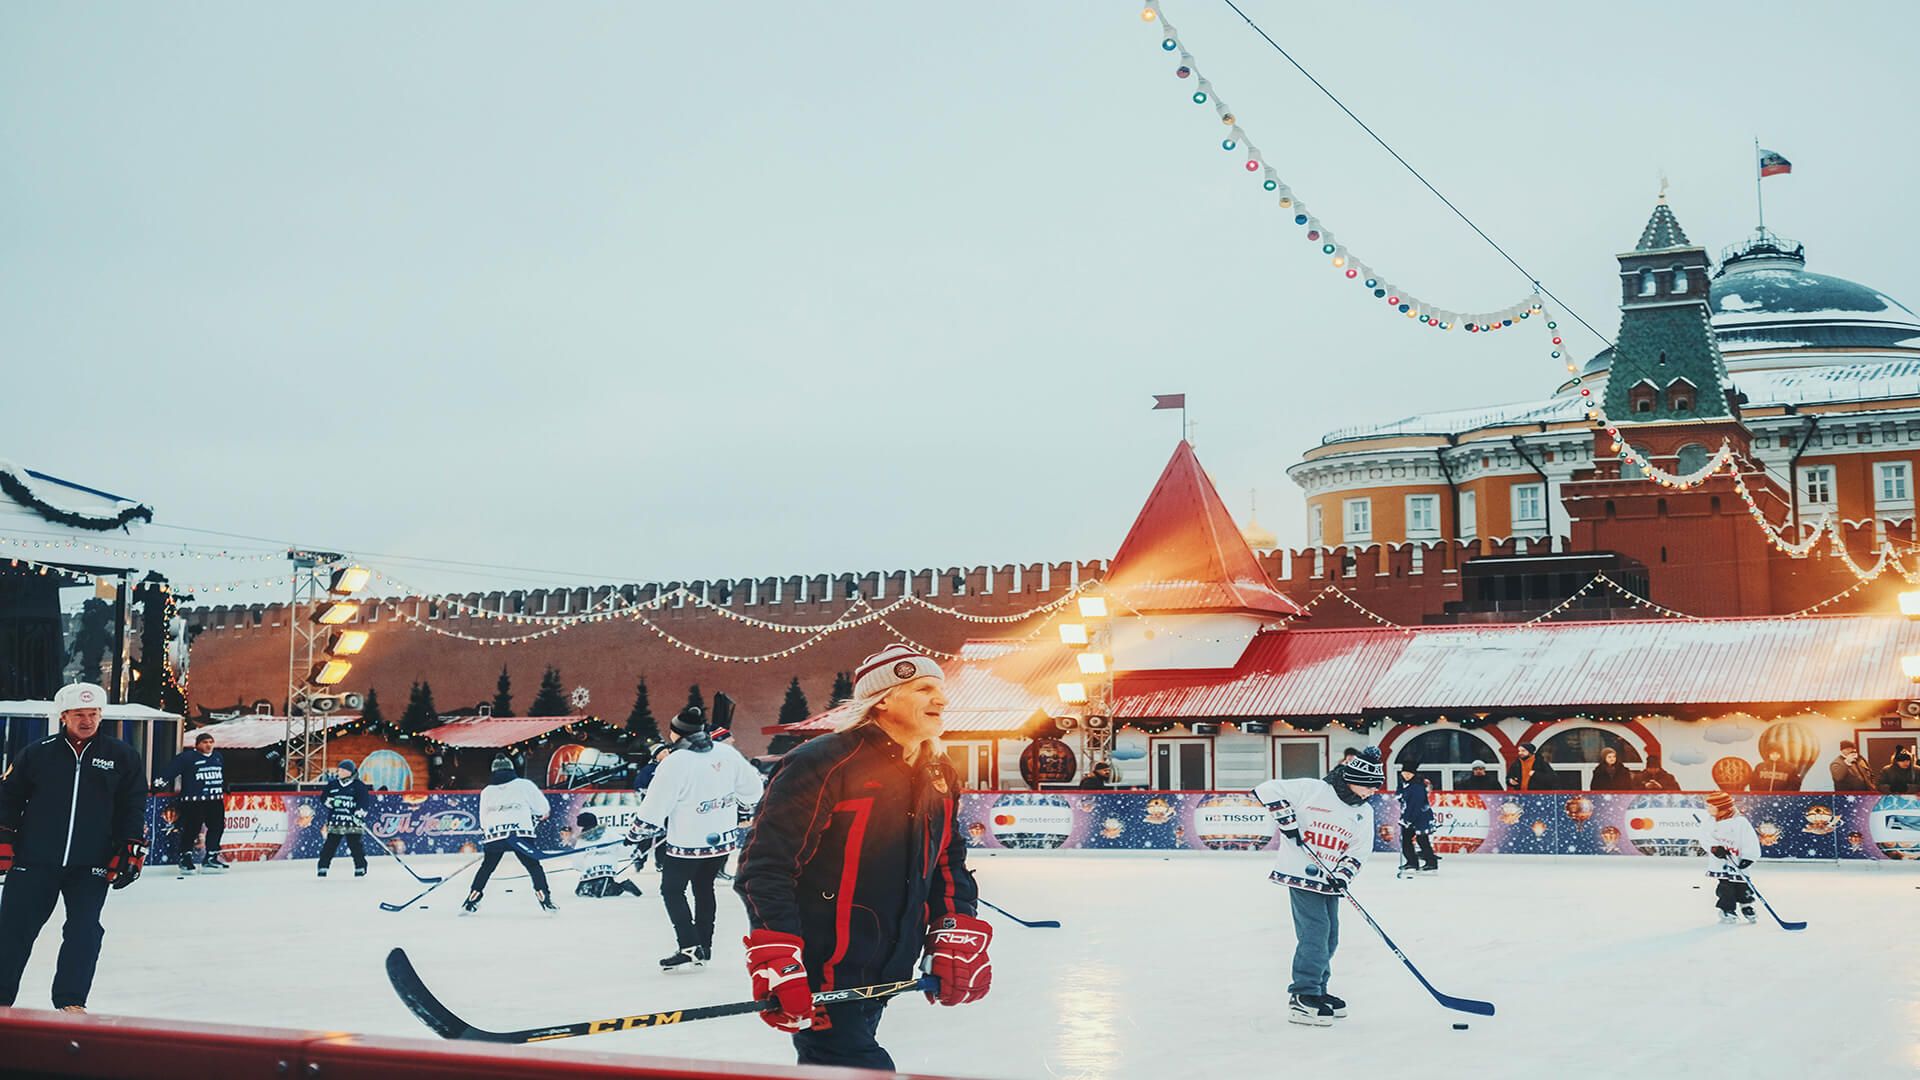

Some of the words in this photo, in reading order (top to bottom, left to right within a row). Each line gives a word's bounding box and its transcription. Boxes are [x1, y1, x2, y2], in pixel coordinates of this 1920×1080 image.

[1020, 816, 1071, 824] mastercard
[1222, 814, 1265, 822] TISSOT
[1659, 820, 1700, 828] masterc
[588, 1010, 683, 1035] CCM
